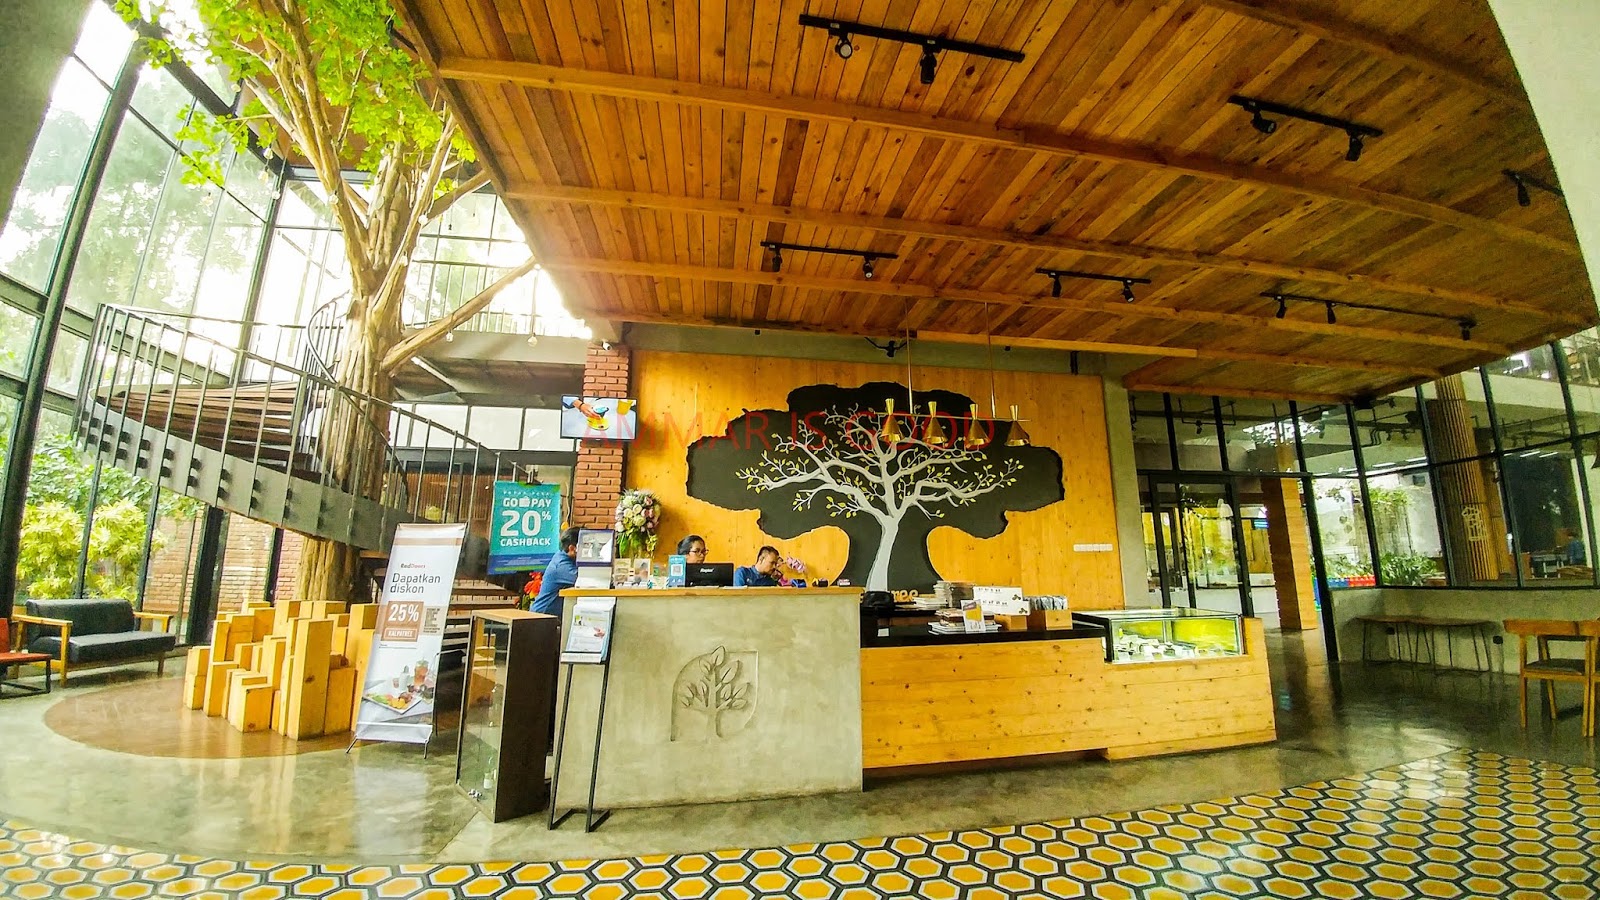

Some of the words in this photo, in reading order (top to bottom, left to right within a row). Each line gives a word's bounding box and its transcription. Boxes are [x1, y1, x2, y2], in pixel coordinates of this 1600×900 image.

[502, 497, 518, 508] GO
[531, 498, 552, 508] PAY
[500, 509, 552, 537] 20%
[500, 537, 551, 547] CASHBACK
[392, 572, 441, 586] Dapatkan
[390, 583, 424, 594] diskon
[388, 603, 420, 622] 25%
